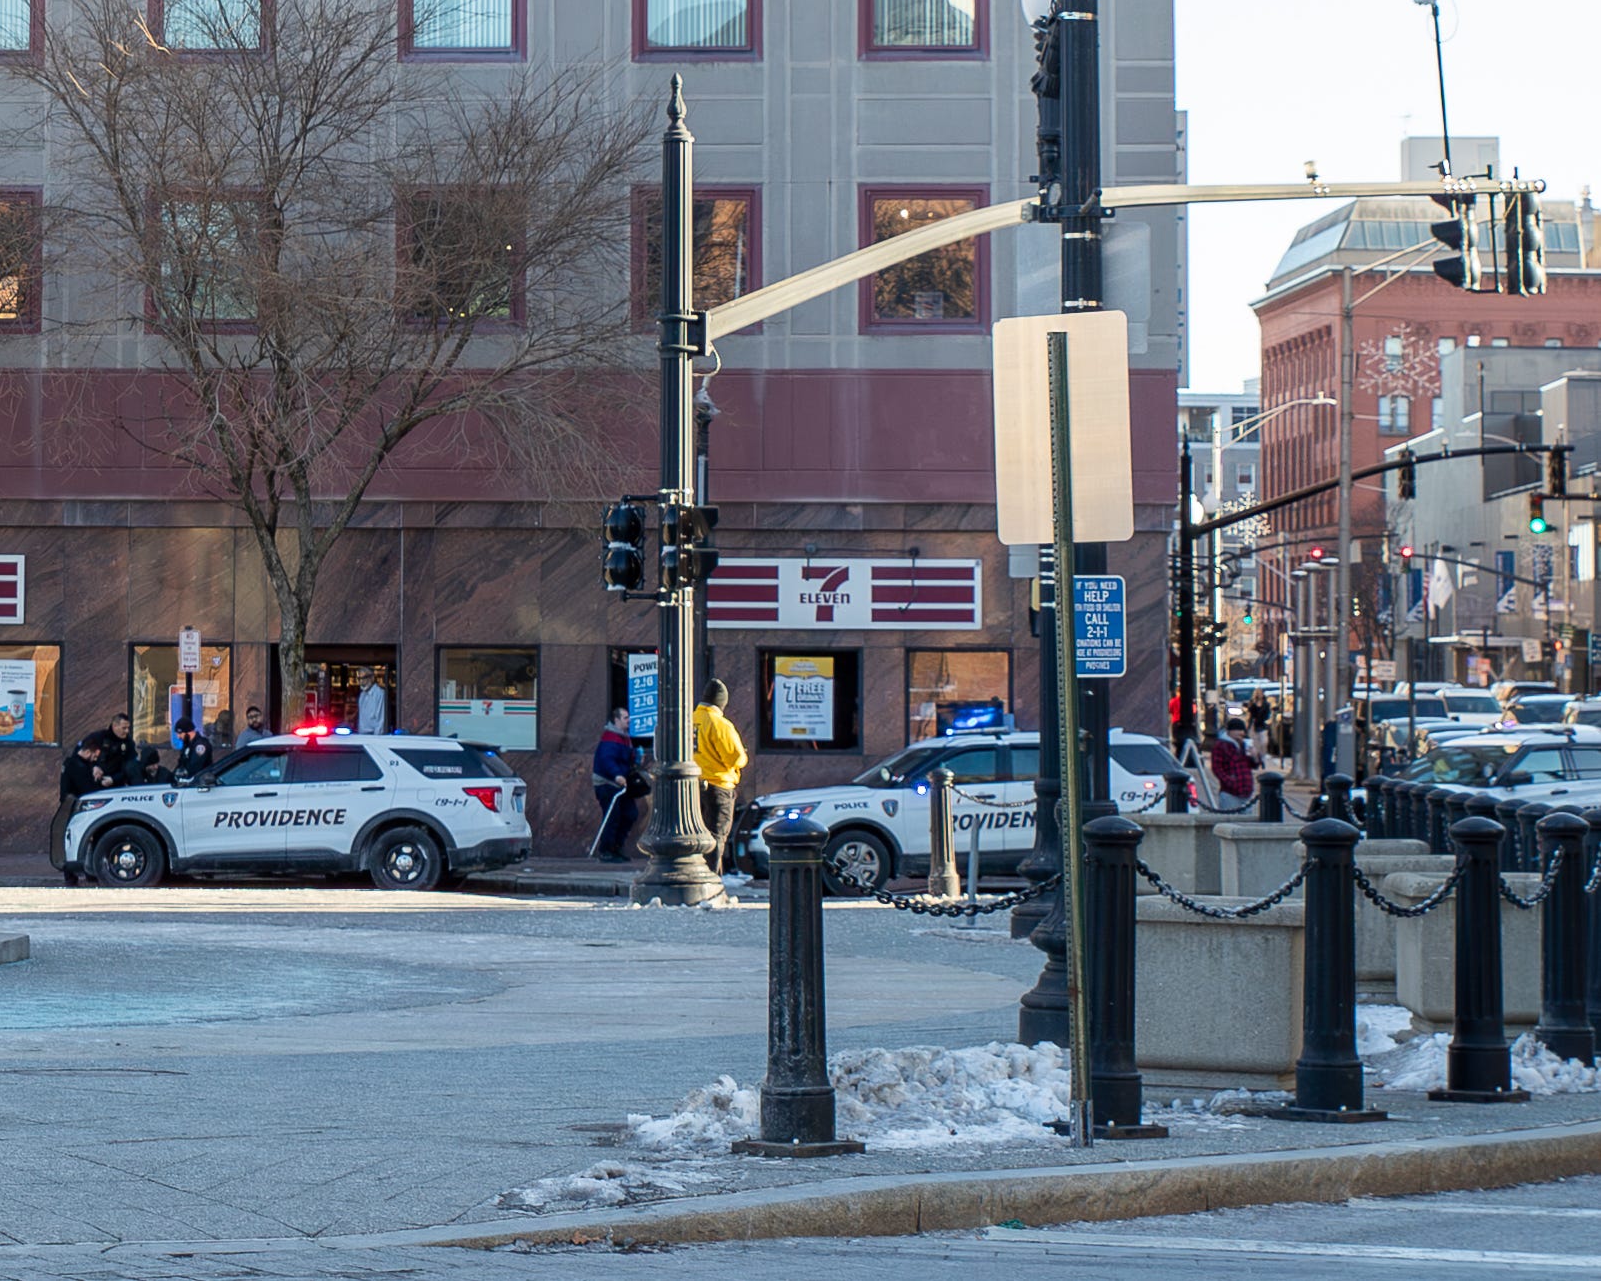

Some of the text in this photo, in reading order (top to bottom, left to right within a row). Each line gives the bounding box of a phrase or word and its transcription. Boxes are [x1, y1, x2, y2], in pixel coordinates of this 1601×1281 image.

[1100, 582, 1118, 590] NEED
[801, 566, 850, 622] 7
[1084, 591, 1109, 602] HELP
[1085, 613, 1109, 625] CALL
[1087, 626, 1108, 638] 2-1-1
[834, 802, 869, 810] POLICE
[214, 808, 346, 829] PROVIDENCE
